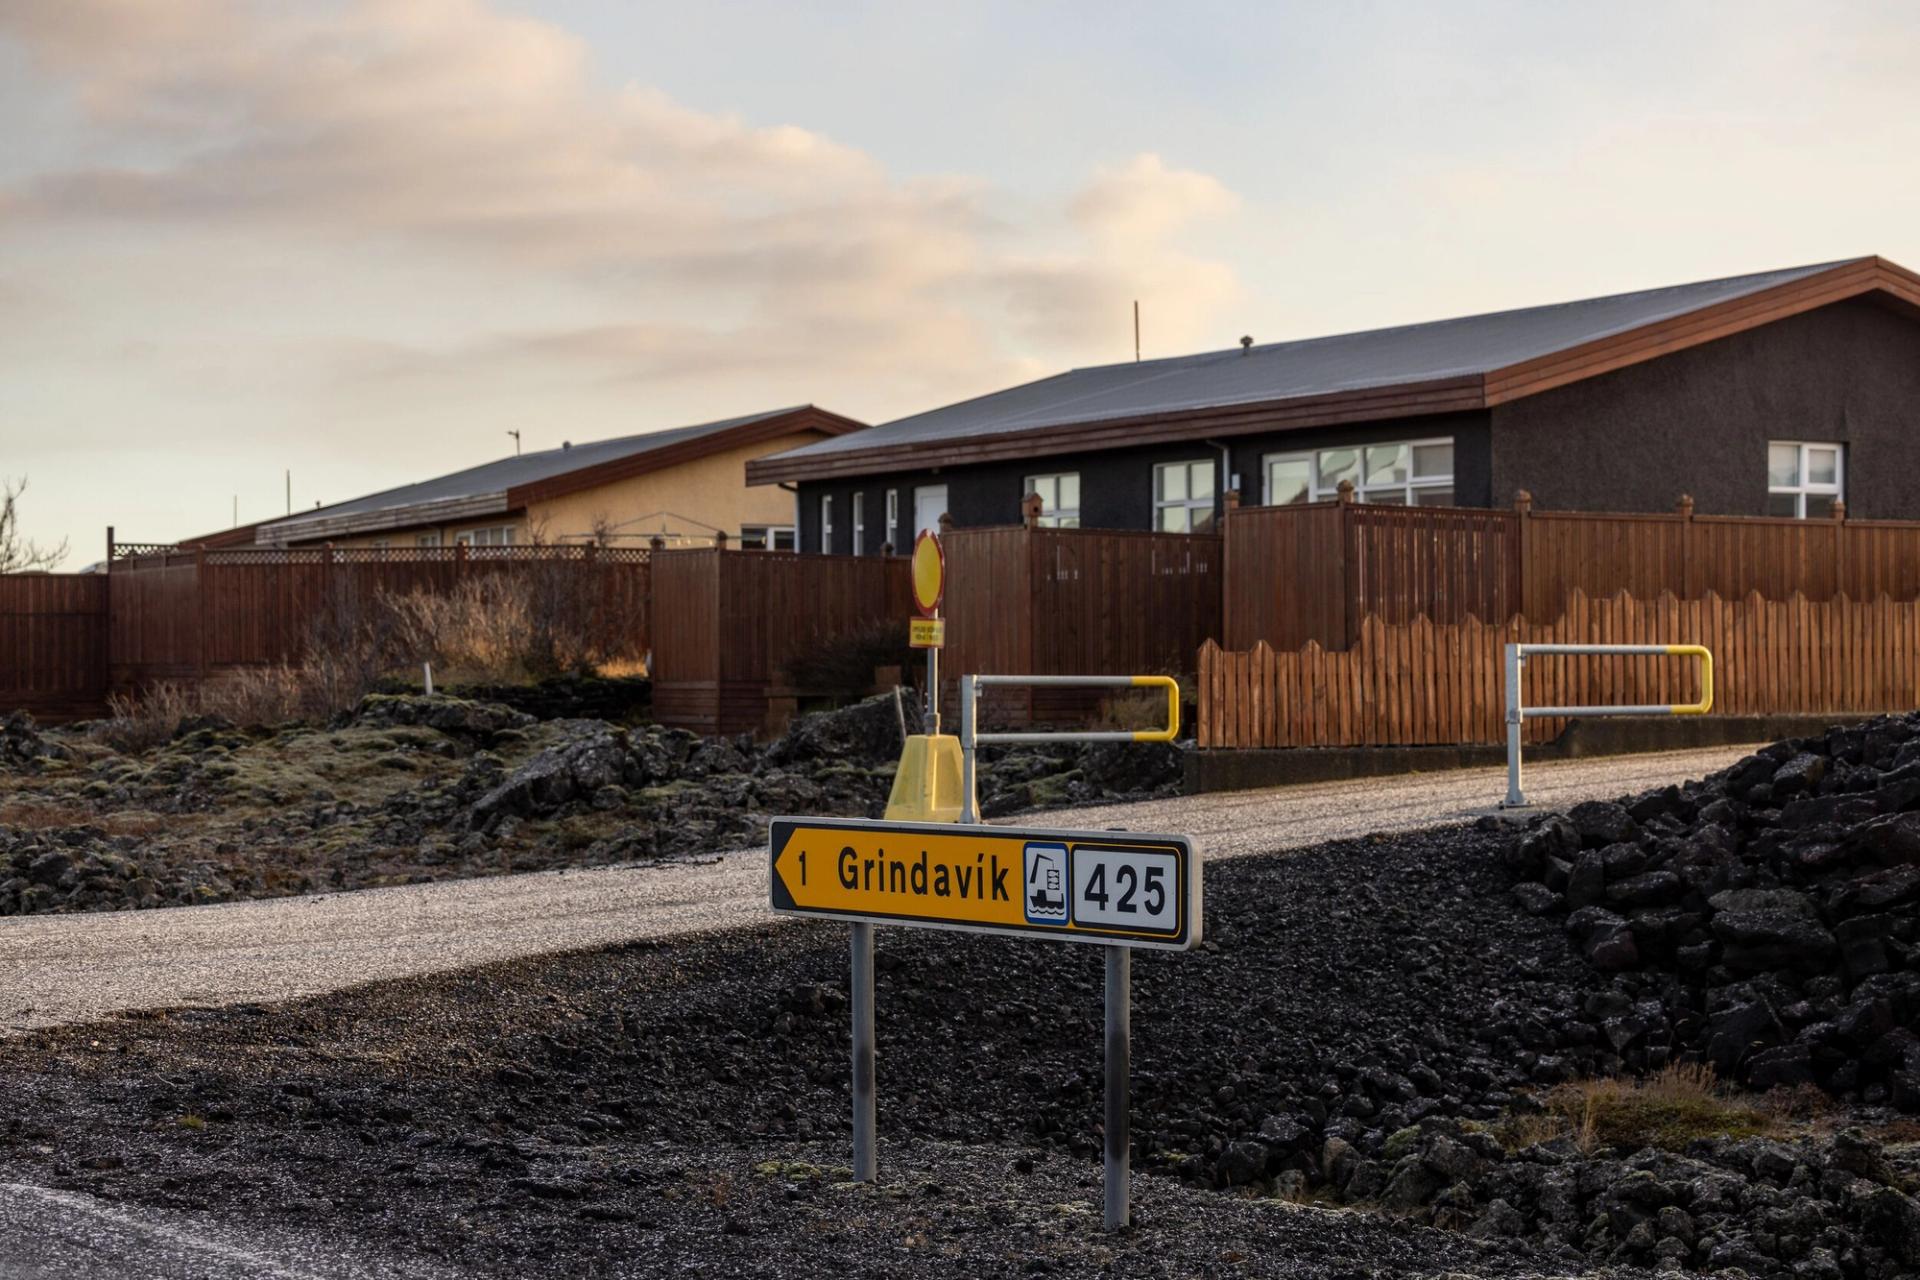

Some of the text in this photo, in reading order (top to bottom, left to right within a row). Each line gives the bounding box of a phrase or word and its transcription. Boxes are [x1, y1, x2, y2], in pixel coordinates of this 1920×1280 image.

[798, 846, 1166, 916] 1 Grindavík 425
